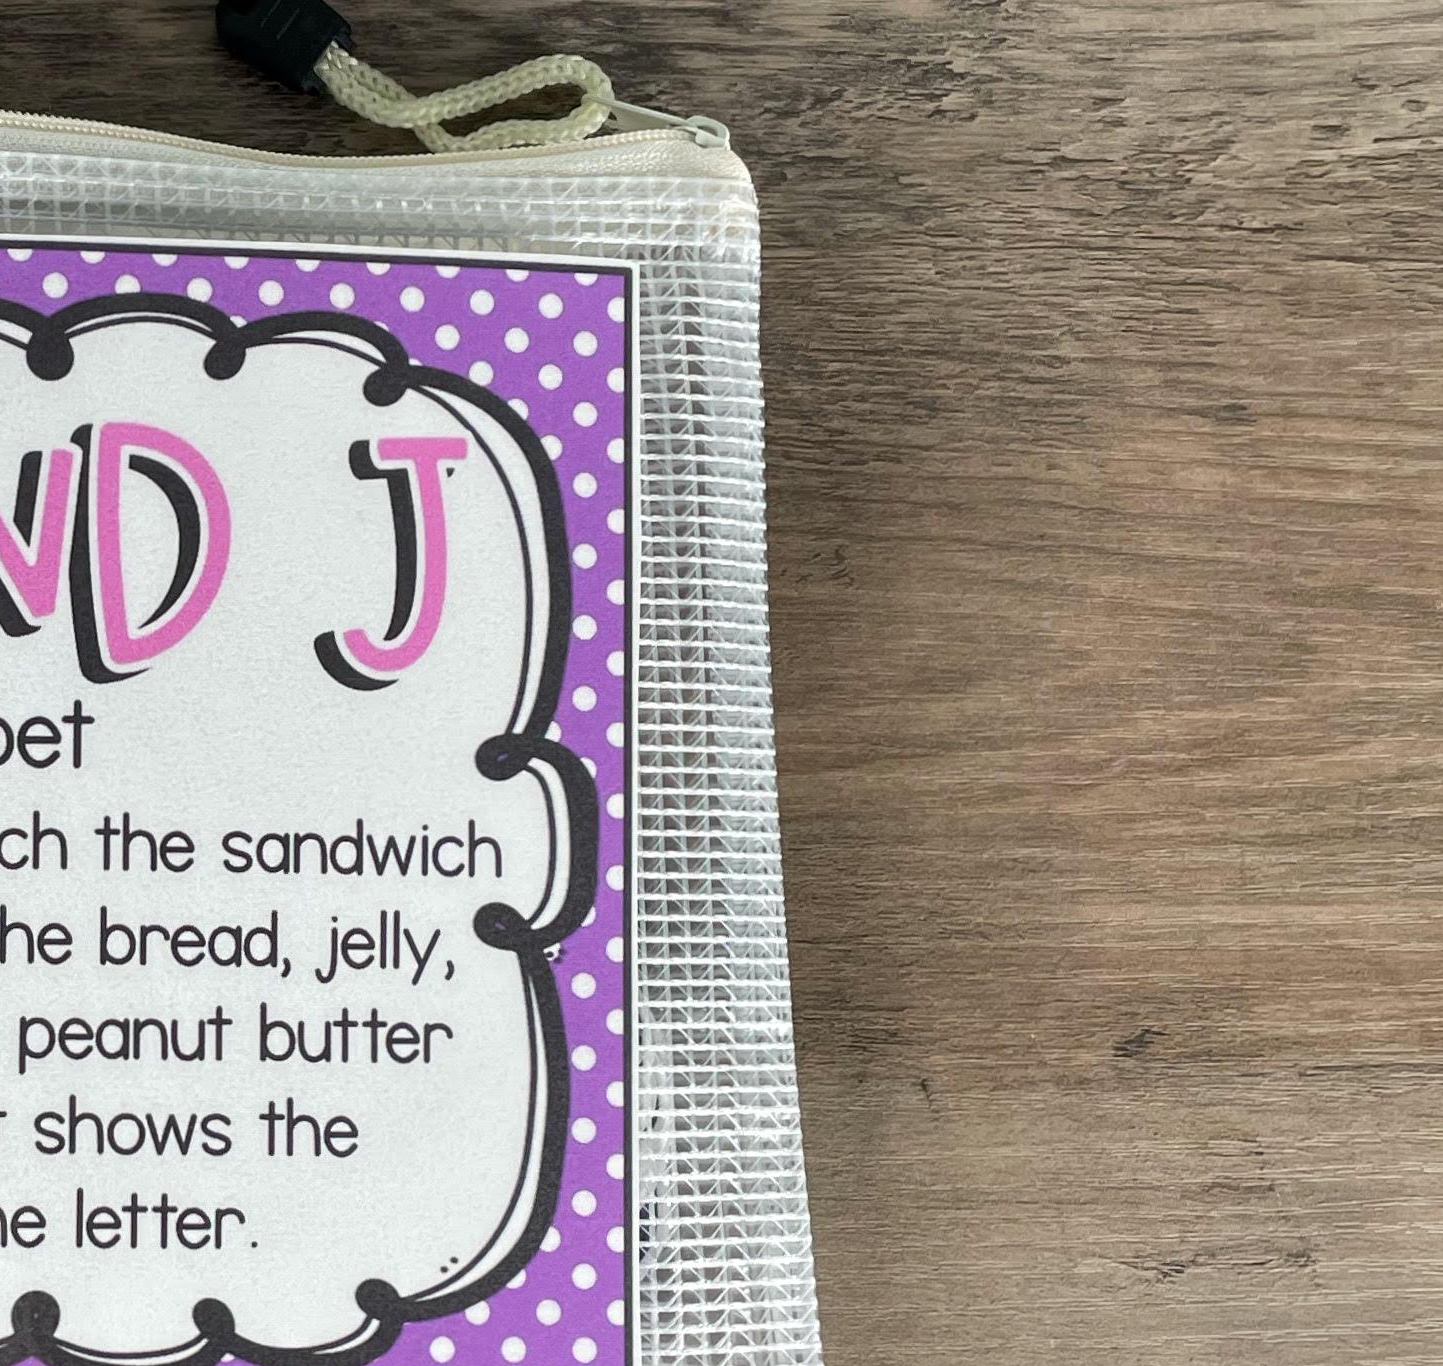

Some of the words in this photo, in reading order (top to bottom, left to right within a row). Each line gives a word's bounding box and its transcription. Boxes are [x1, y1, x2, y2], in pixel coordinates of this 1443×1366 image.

[313, 435, 469, 692] J
[95, 812, 194, 872] the
[222, 819, 501, 877] sandwich
[100, 906, 291, 977] bread,
[315, 911, 454, 985] jelly,
[19, 1006, 232, 1074] peanut
[260, 1003, 453, 1063] butter
[34, 1095, 231, 1156] shows
[259, 1098, 358, 1157] the
[76, 1188, 259, 1249] letter.
